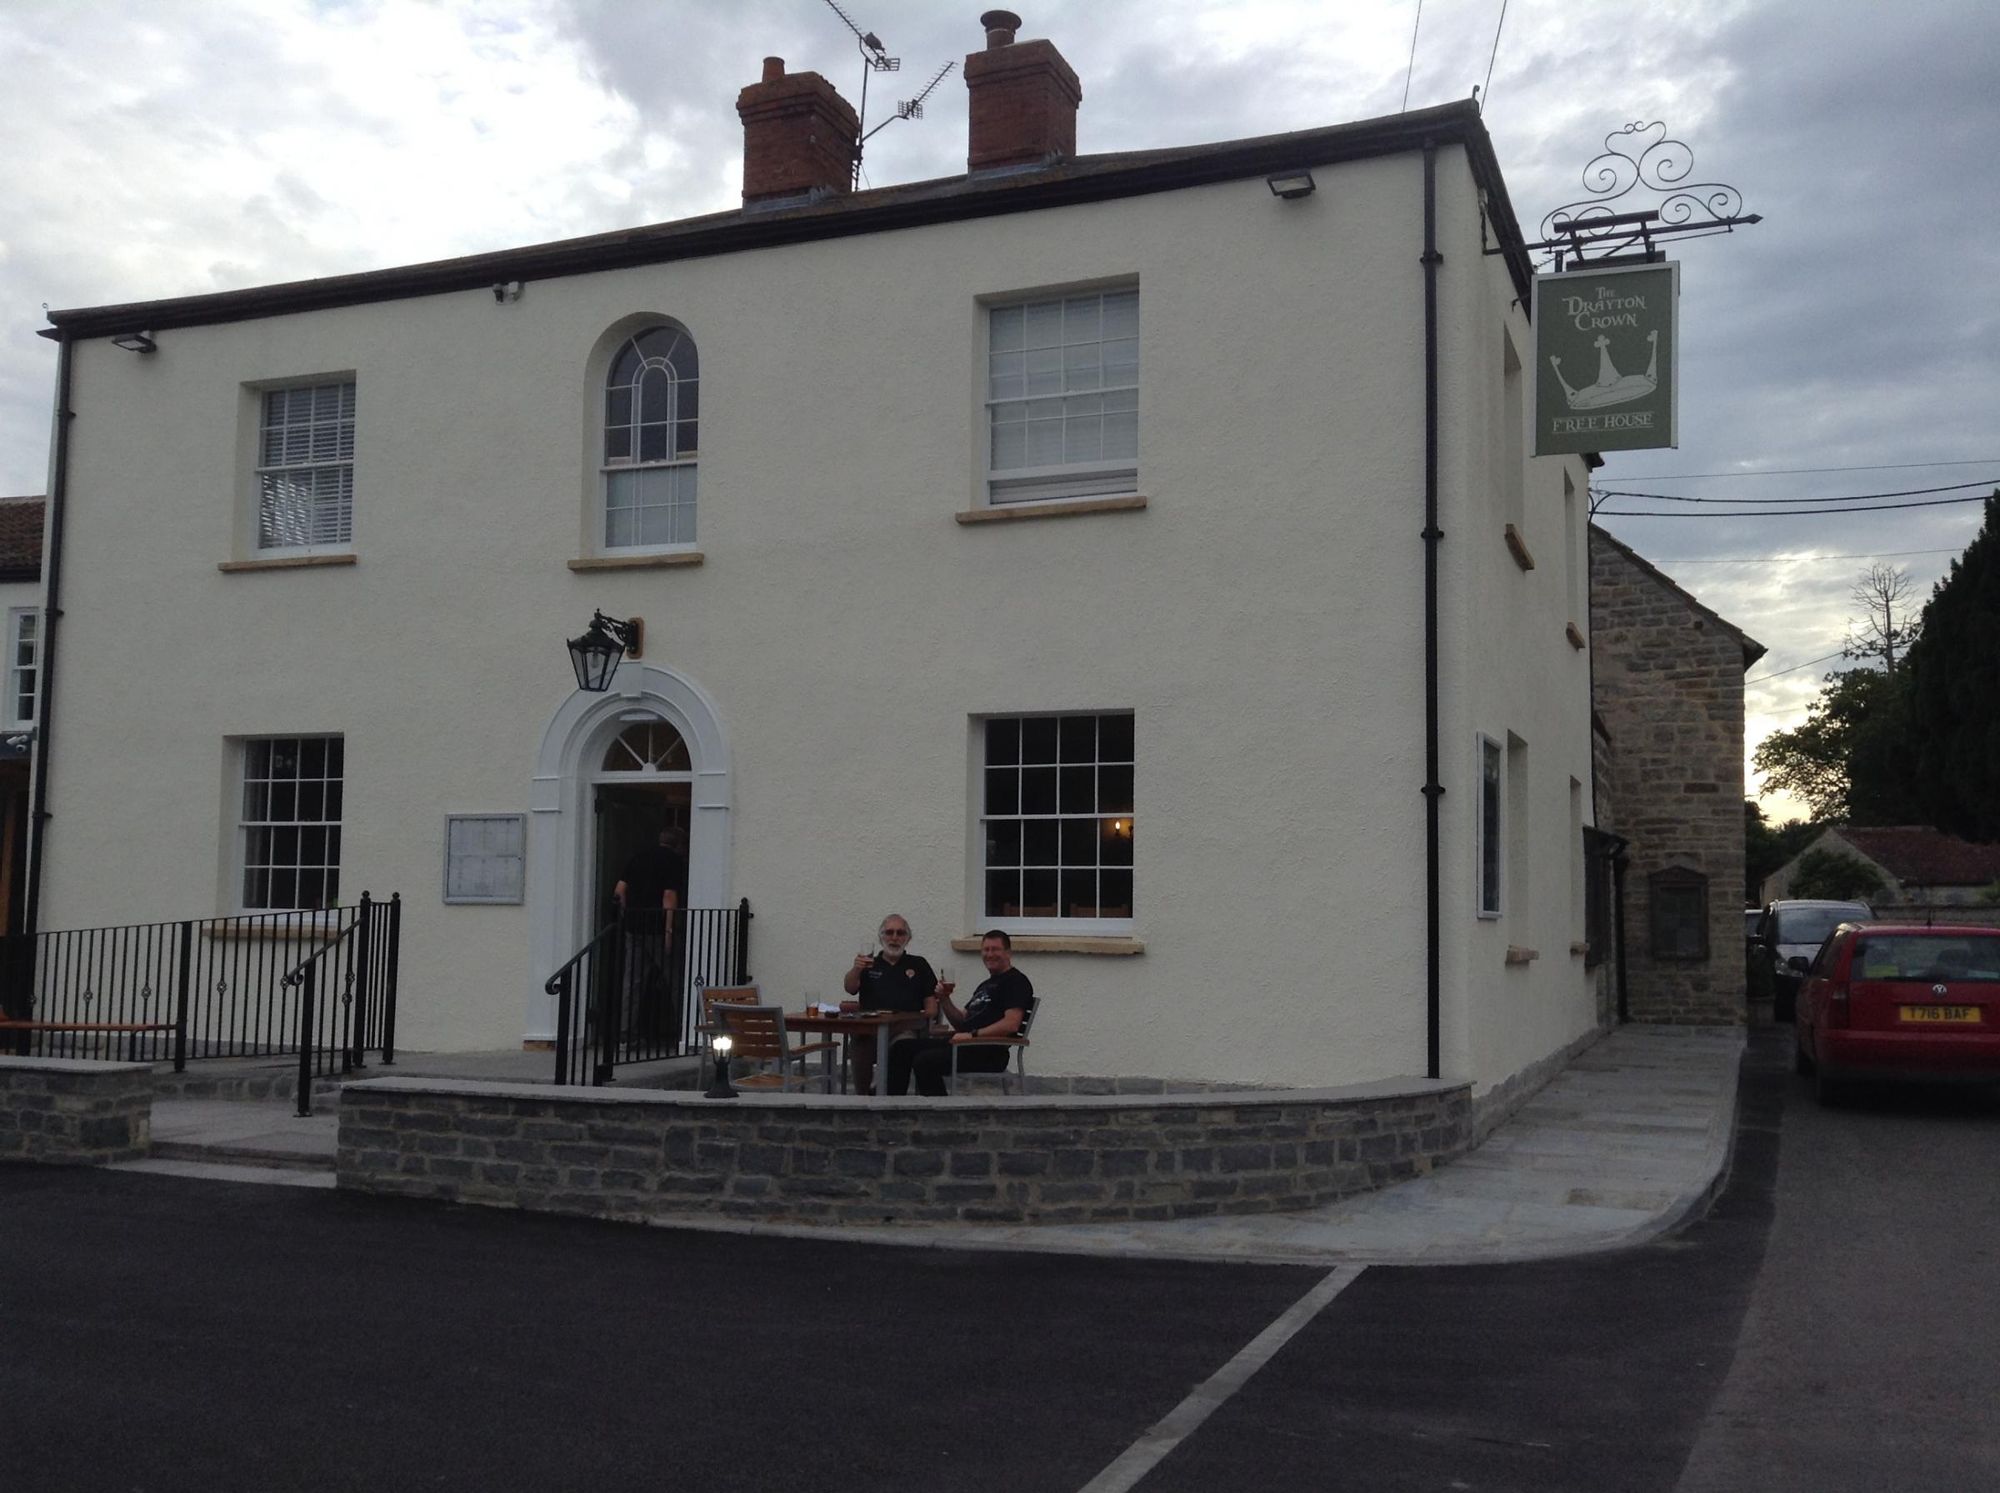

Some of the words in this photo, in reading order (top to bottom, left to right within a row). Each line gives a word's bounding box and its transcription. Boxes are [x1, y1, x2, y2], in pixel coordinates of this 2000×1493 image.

[1563, 296, 1646, 316] DRAYTON
[1575, 313, 1638, 331] CROWN
[1553, 418, 1597, 432] FREE
[1604, 414, 1652, 428] HOUSE
